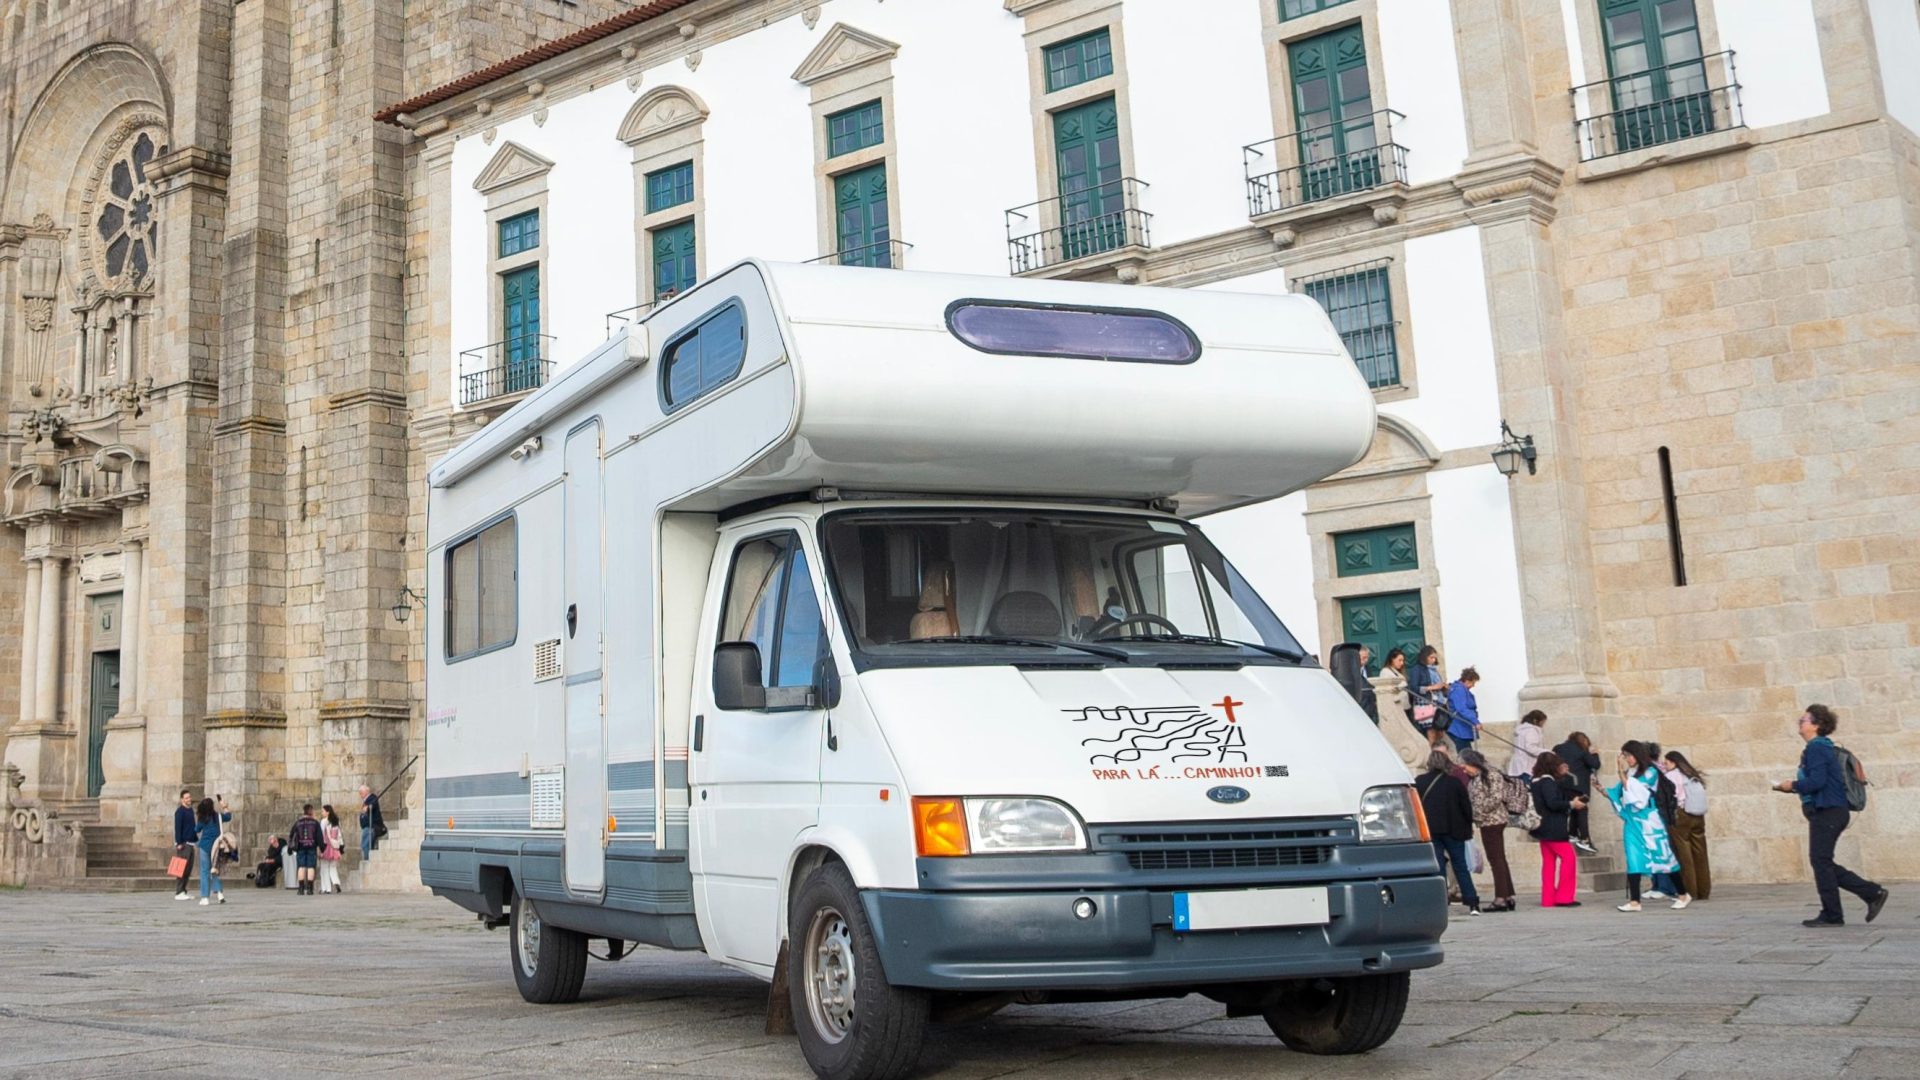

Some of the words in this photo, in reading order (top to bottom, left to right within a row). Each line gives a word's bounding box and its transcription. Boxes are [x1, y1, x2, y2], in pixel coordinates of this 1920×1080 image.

[1092, 769, 1131, 780] PARA
[1183, 766, 1262, 779] CAMINHO!
[1216, 788, 1241, 799] Ford
[1179, 915, 1186, 924] P
